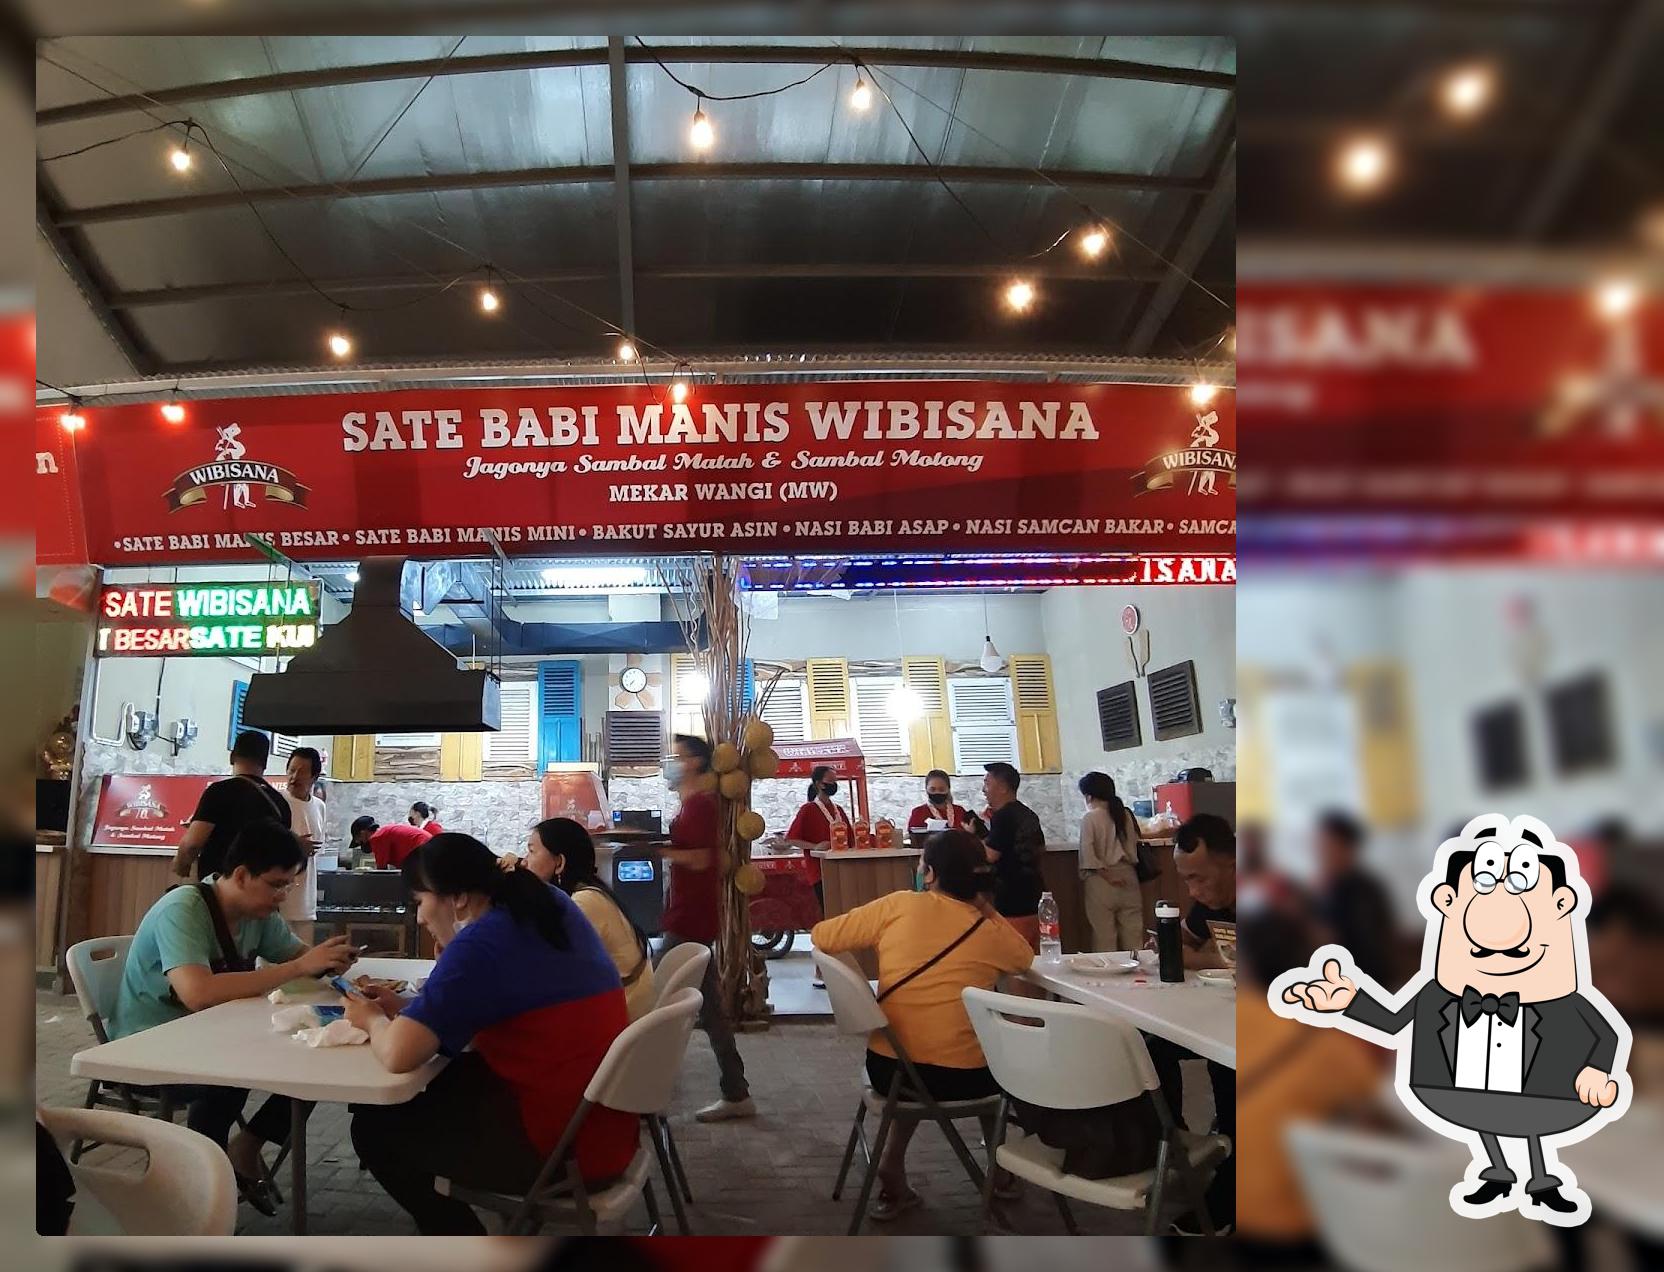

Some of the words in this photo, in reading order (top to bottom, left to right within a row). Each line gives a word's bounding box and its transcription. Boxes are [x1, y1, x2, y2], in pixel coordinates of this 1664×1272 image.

[343, 410, 463, 451] SATE
[480, 406, 599, 447] BABI
[616, 403, 790, 445] MANIS
[805, 401, 1099, 439] WIBISANA
[189, 462, 279, 485] WIBISANA
[463, 457, 567, 479] Jagonya
[574, 455, 666, 473] Sambal
[673, 453, 754, 470] Matah
[762, 452, 781, 468] &
[791, 451, 884, 469] Sambal
[1162, 450, 1236, 470] WIBISAN
[609, 484, 688, 501] MEKAR
[695, 483, 772, 500] WANGI
[780, 482, 837, 502] (MW)
[123, 536, 164, 551] SATE
[168, 535, 209, 549] BABI
[281, 531, 339, 546] BESAR
[356, 529, 401, 544] SATE
[407, 528, 451, 543] BABI
[457, 527, 521, 544] MANIS
[528, 526, 575, 540] MINI
[593, 524, 657, 539] BAKUT
[664, 523, 724, 538] SAYUR
[730, 522, 777, 537] ASIN
[795, 521, 841, 536] NASI
[848, 520, 893, 535] BABI
[898, 520, 948, 534] ASAP
[966, 520, 1012, 534] NASI
[1018, 519, 1100, 534] SAMCAN
[1105, 519, 1164, 533] BAKAR
[105, 591, 171, 617] SATE
[177, 588, 311, 616] WIBISANA
